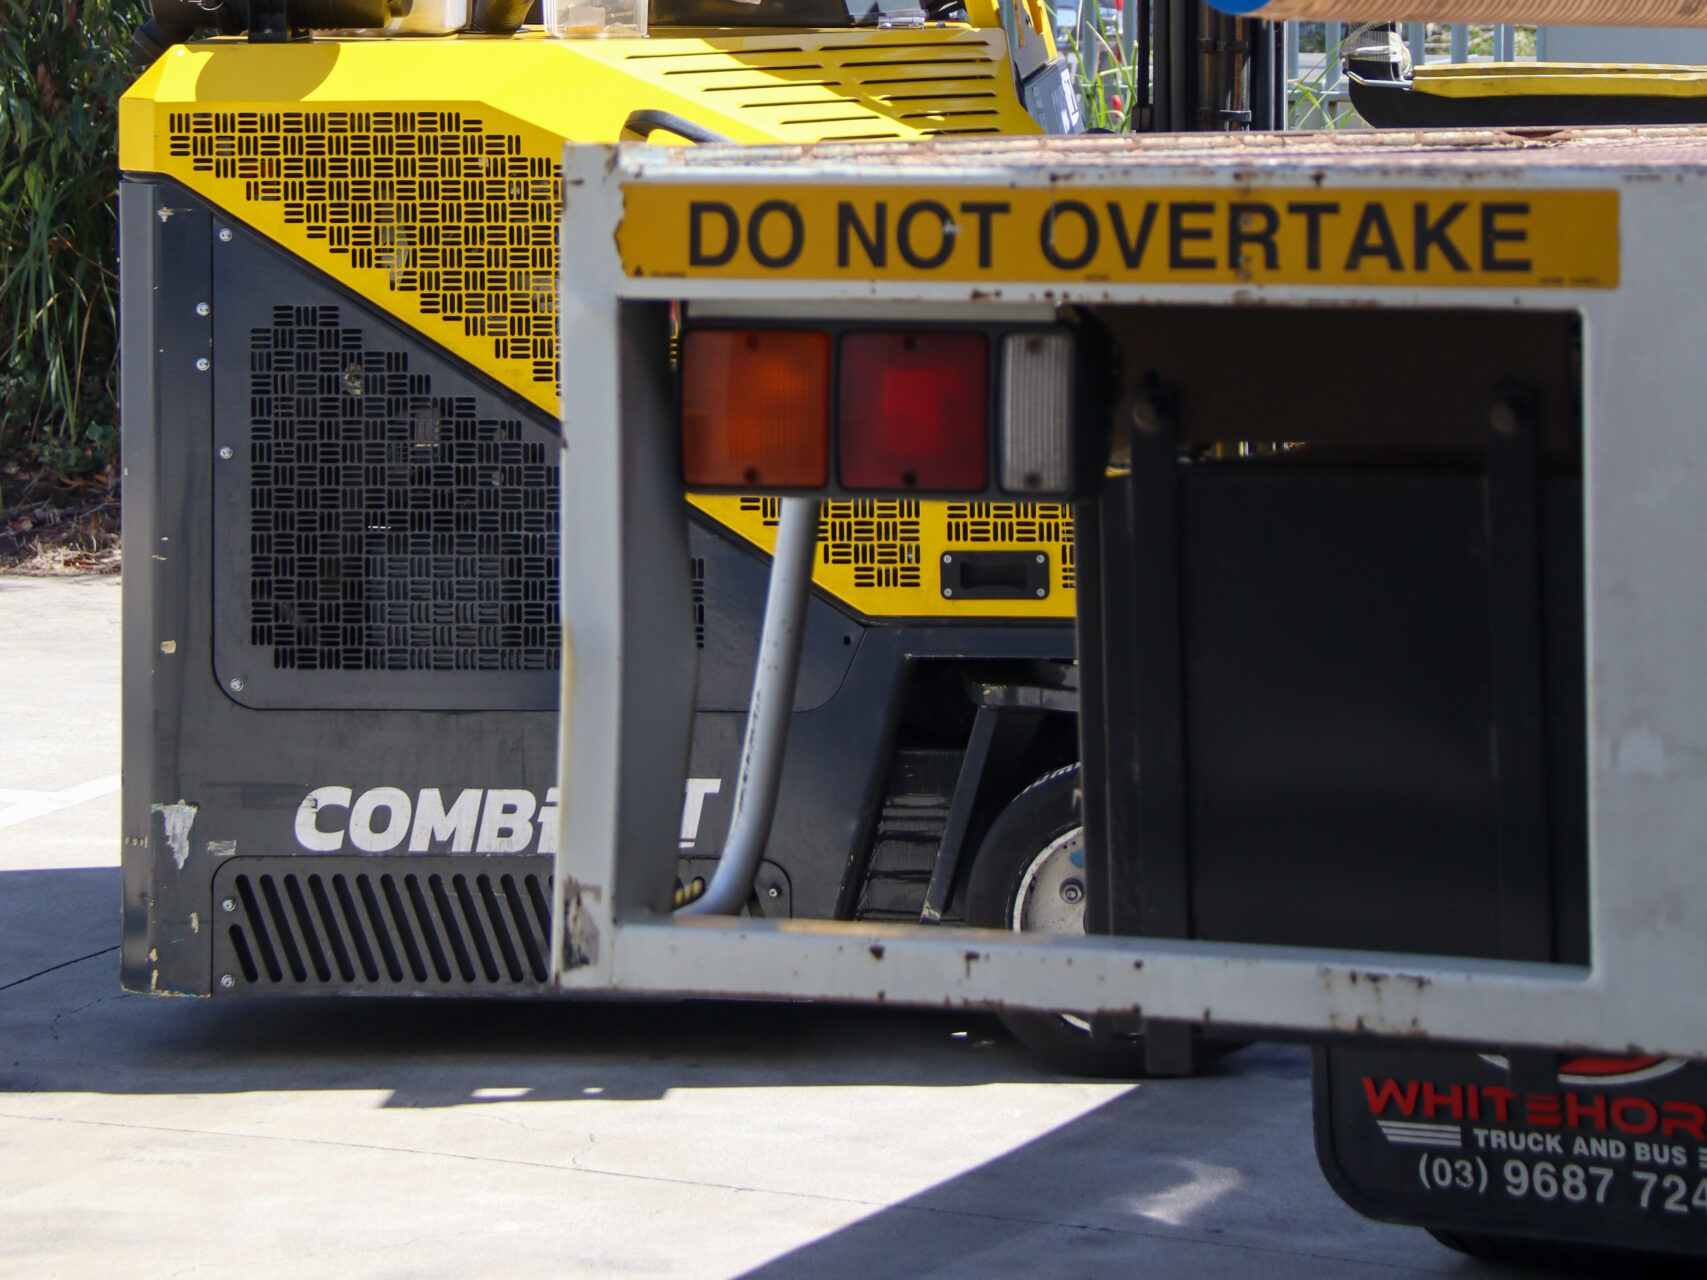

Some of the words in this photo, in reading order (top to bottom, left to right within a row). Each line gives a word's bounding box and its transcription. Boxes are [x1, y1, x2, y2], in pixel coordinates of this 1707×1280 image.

[689, 199, 805, 269] DO
[837, 199, 1011, 270] NOT
[1039, 199, 1533, 274] OVERTAKE
[1473, 1127, 1563, 1154] TRUCK
[1572, 1136, 1627, 1161] AND
[1634, 1141, 1689, 1166] BUS
[1418, 1151, 1489, 1195] (03)
[1503, 1158, 1615, 1204] 9687
